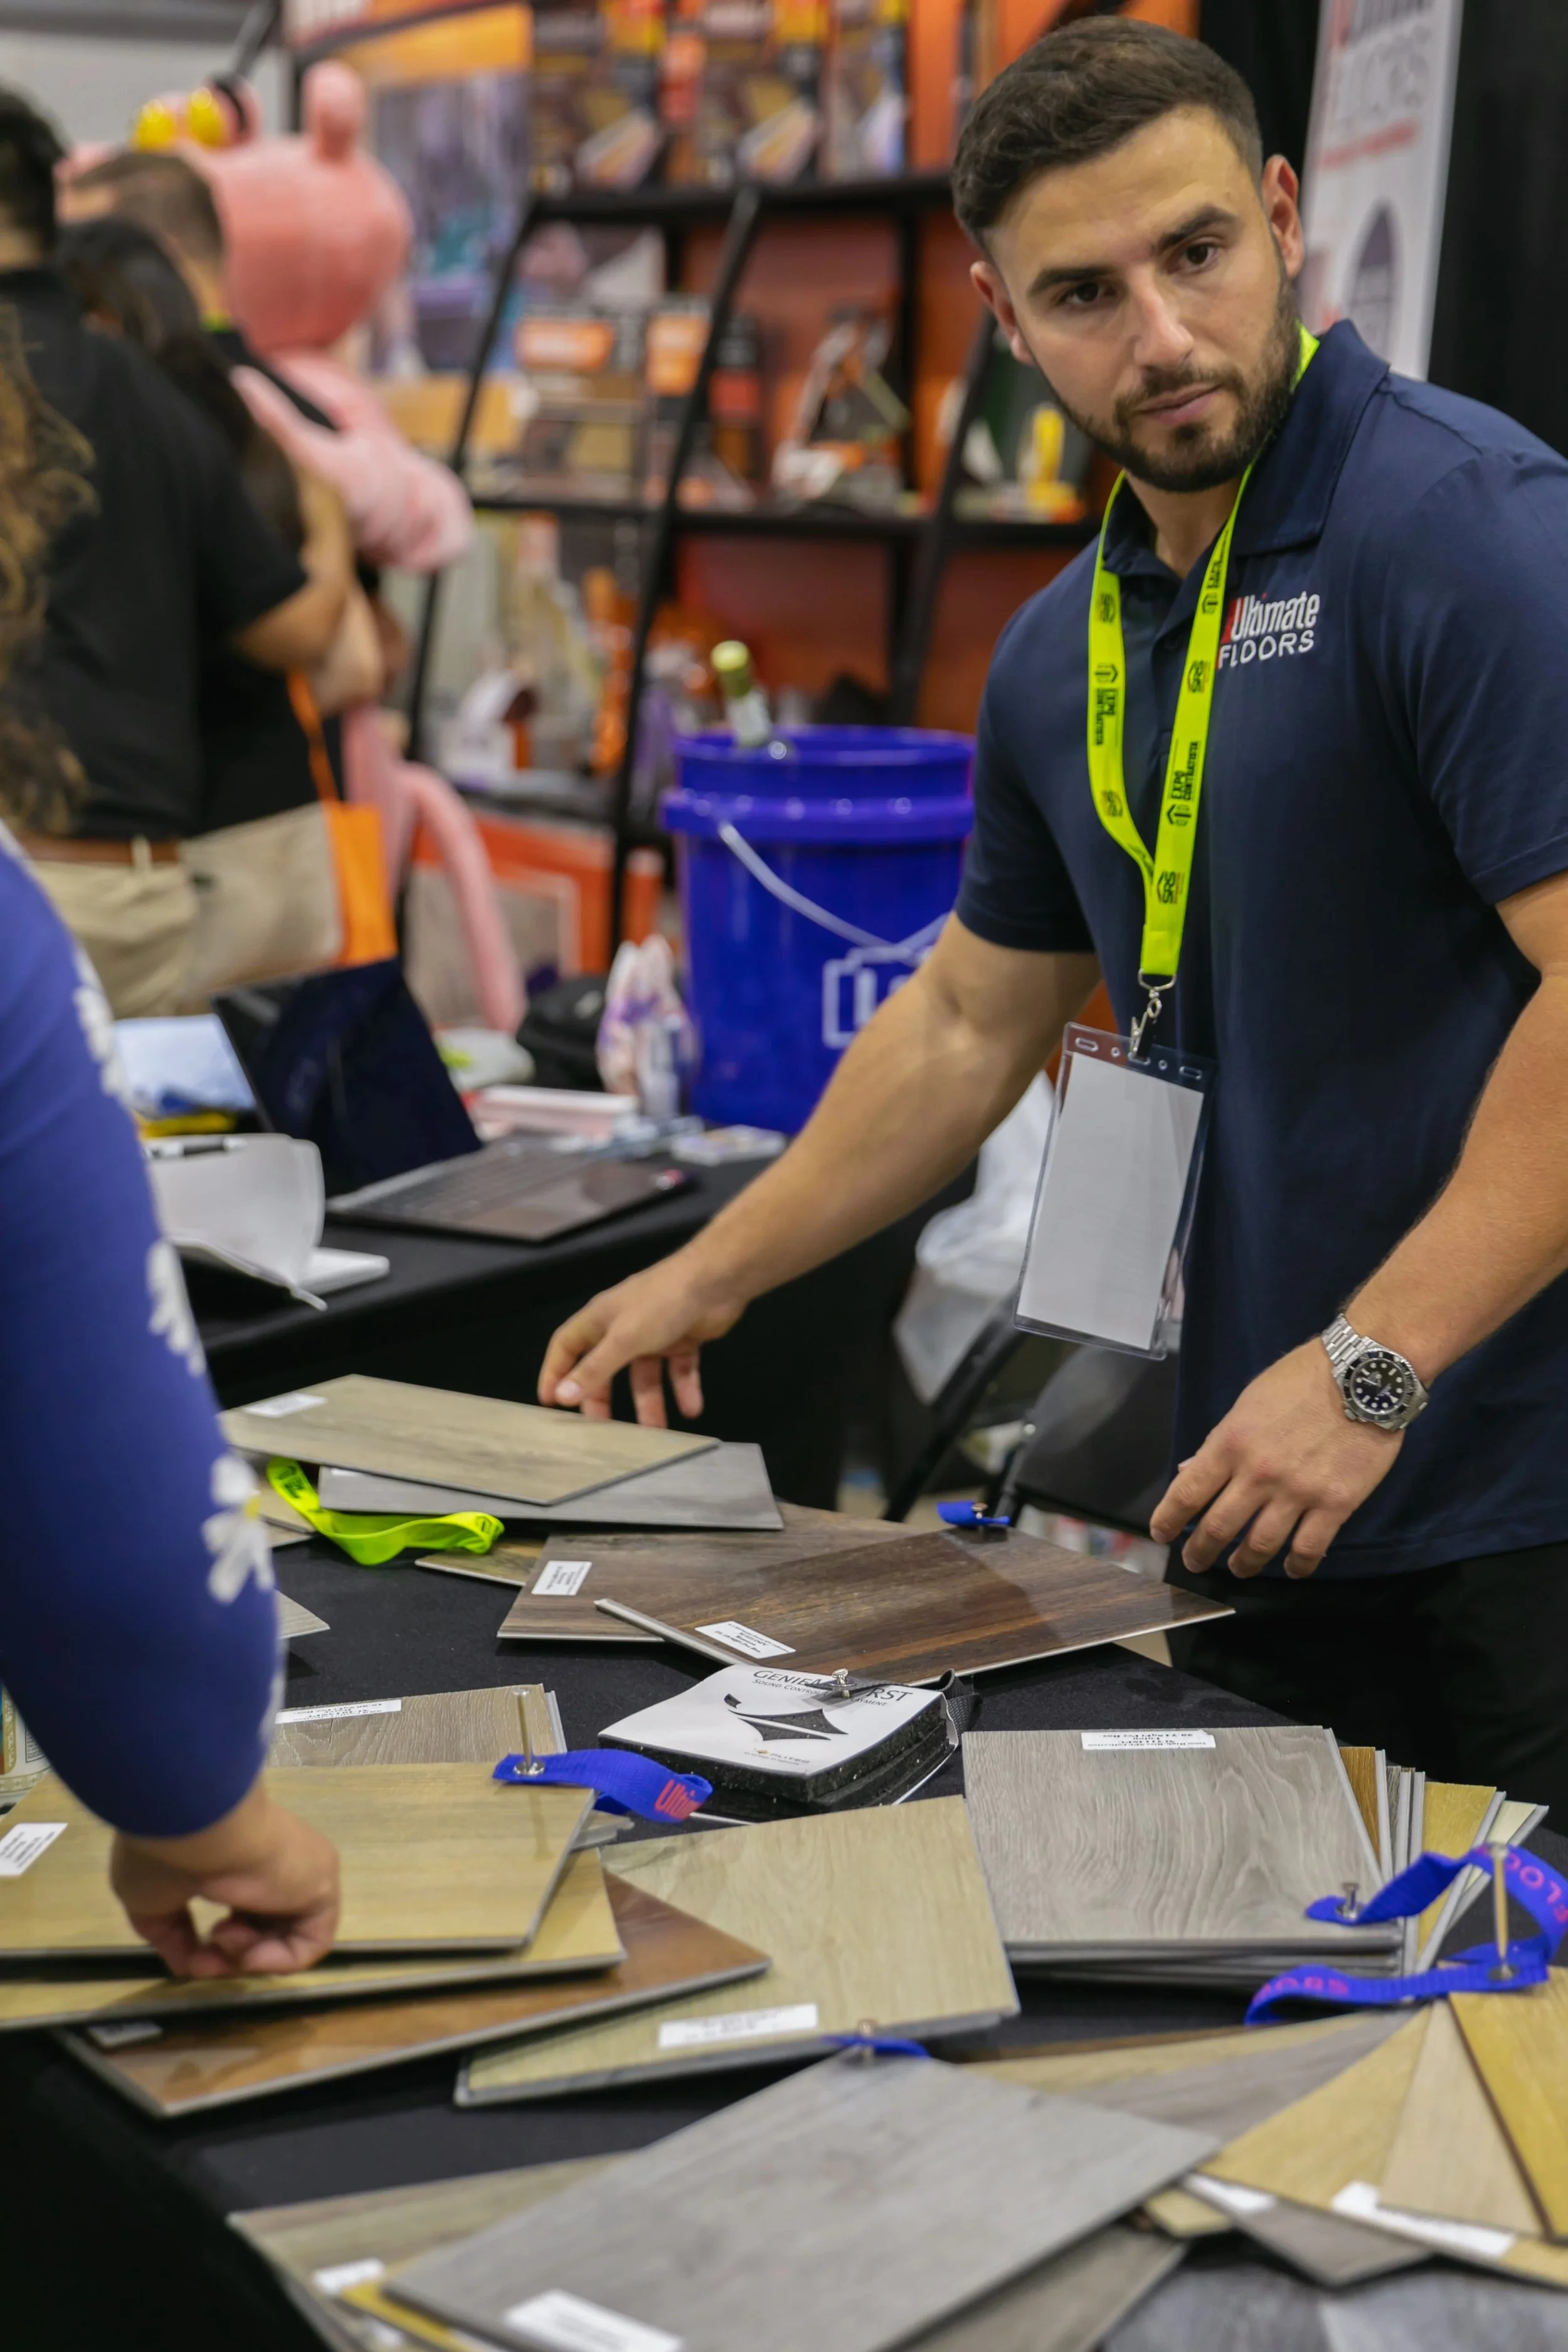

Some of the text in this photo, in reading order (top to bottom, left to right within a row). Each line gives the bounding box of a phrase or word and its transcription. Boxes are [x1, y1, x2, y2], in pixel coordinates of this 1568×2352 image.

[1231, 591, 1320, 642] Ultimate
[1217, 630, 1315, 669] FLOORS
[1171, 771, 1185, 800] EXPO
[753, 1679, 782, 1688] SOUND
